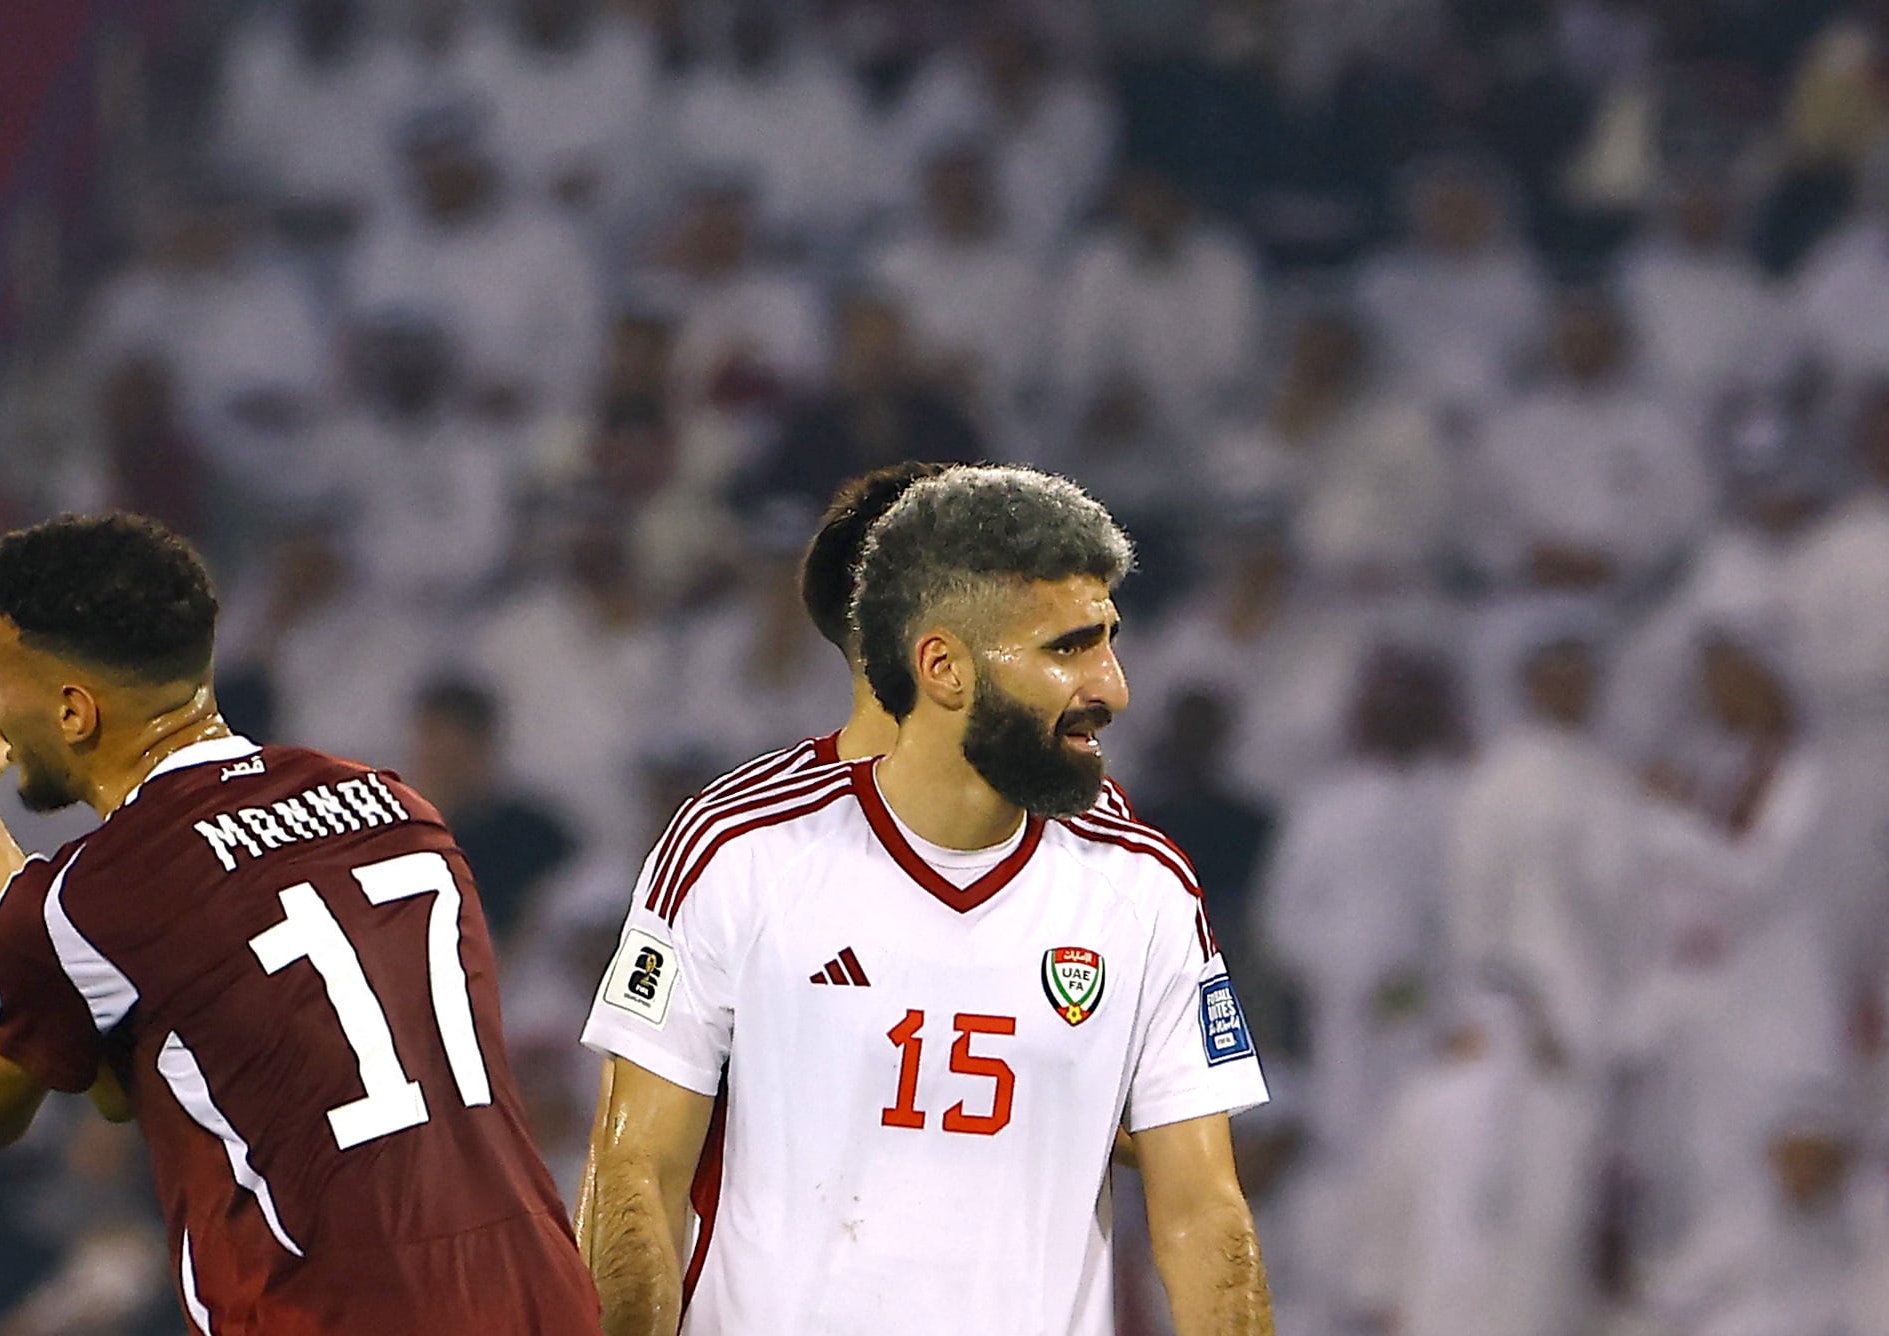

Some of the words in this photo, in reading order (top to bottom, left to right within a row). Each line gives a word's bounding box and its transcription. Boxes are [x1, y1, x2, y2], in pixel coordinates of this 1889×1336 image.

[194, 772, 410, 873] MANNAI
[247, 850, 493, 1151] 17
[1061, 966, 1091, 982] UAE
[1068, 980, 1085, 992] FA
[881, 1008, 1017, 1136] 15
